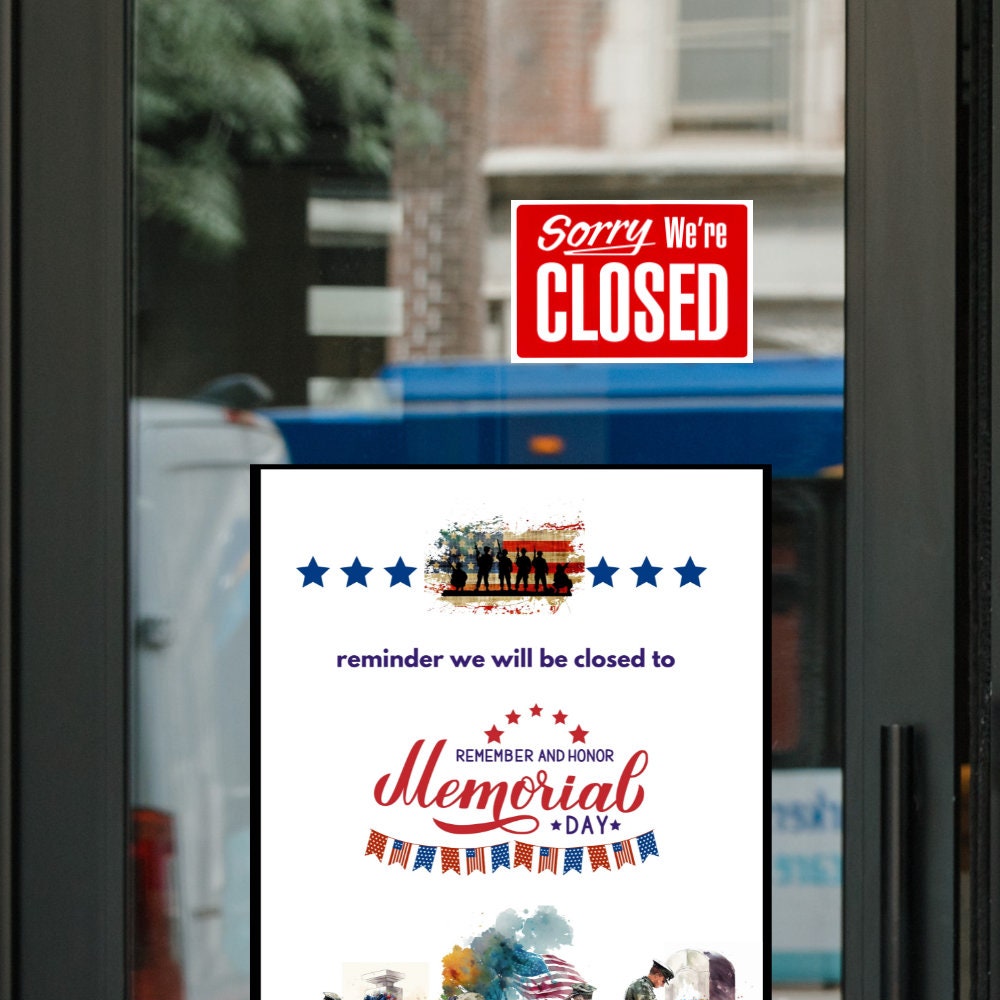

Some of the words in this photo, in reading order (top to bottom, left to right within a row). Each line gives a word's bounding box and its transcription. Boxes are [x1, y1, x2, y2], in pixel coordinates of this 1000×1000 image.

[537, 214, 656, 256] Sorry
[664, 216, 728, 249] We're
[536, 261, 729, 343] CLOSED
[336, 647, 444, 669] reminder
[450, 654, 486, 669] we
[491, 647, 533, 669] will
[539, 647, 568, 669] be
[574, 647, 646, 669] closed
[651, 650, 676, 669] to
[455, 748, 534, 763] REMEMBER
[538, 748, 565, 763] AND
[568, 748, 615, 763] HONOR
[373, 738, 649, 835] Memorial
[565, 814, 609, 835] DAY
